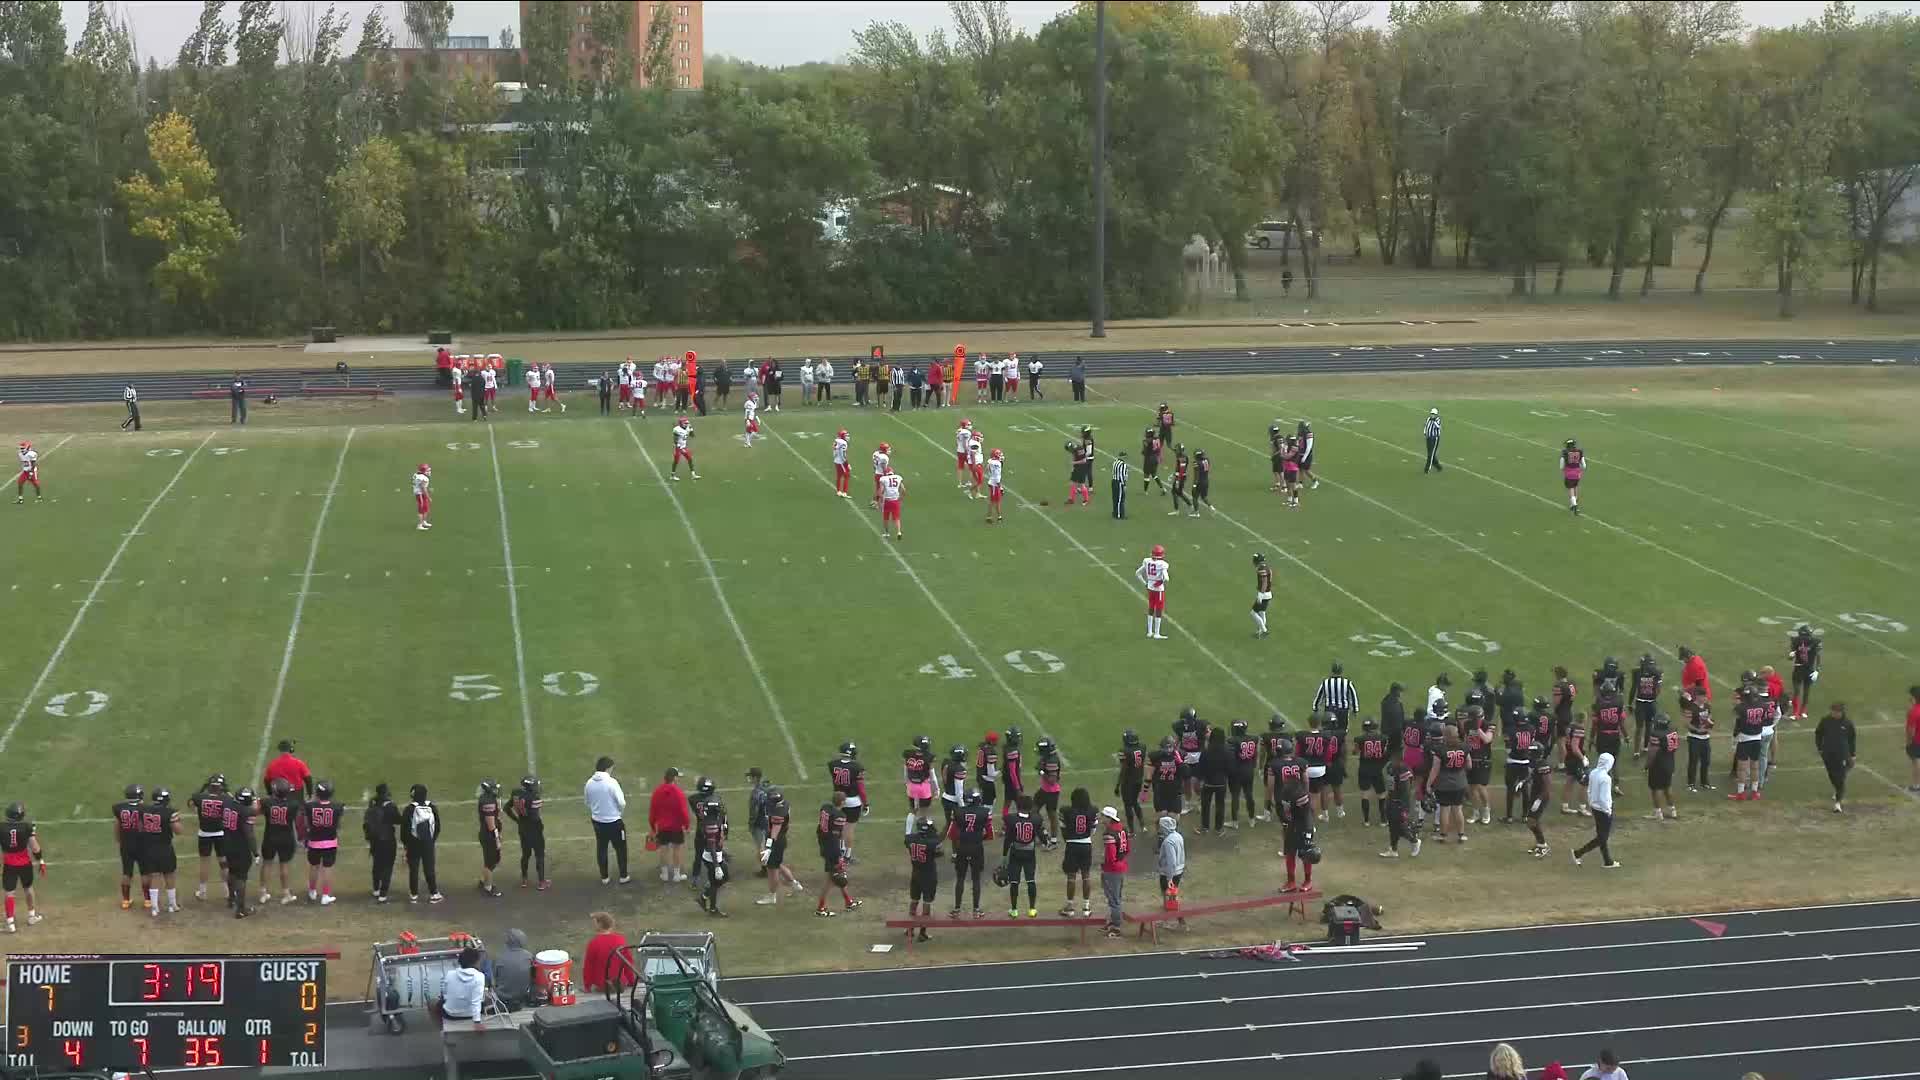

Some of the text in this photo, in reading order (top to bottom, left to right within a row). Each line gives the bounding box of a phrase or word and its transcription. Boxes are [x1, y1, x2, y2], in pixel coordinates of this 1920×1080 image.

[888, 478, 898, 487] 15
[1147, 563, 1157, 576] 12
[1306, 736, 1323, 754] 74
[271, 806, 288, 825] 91
[312, 807, 334, 828] 50
[965, 813, 977, 833] 7
[9, 828, 18, 849] 1
[911, 842, 928, 863] 15
[549, 970, 560, 982] G
